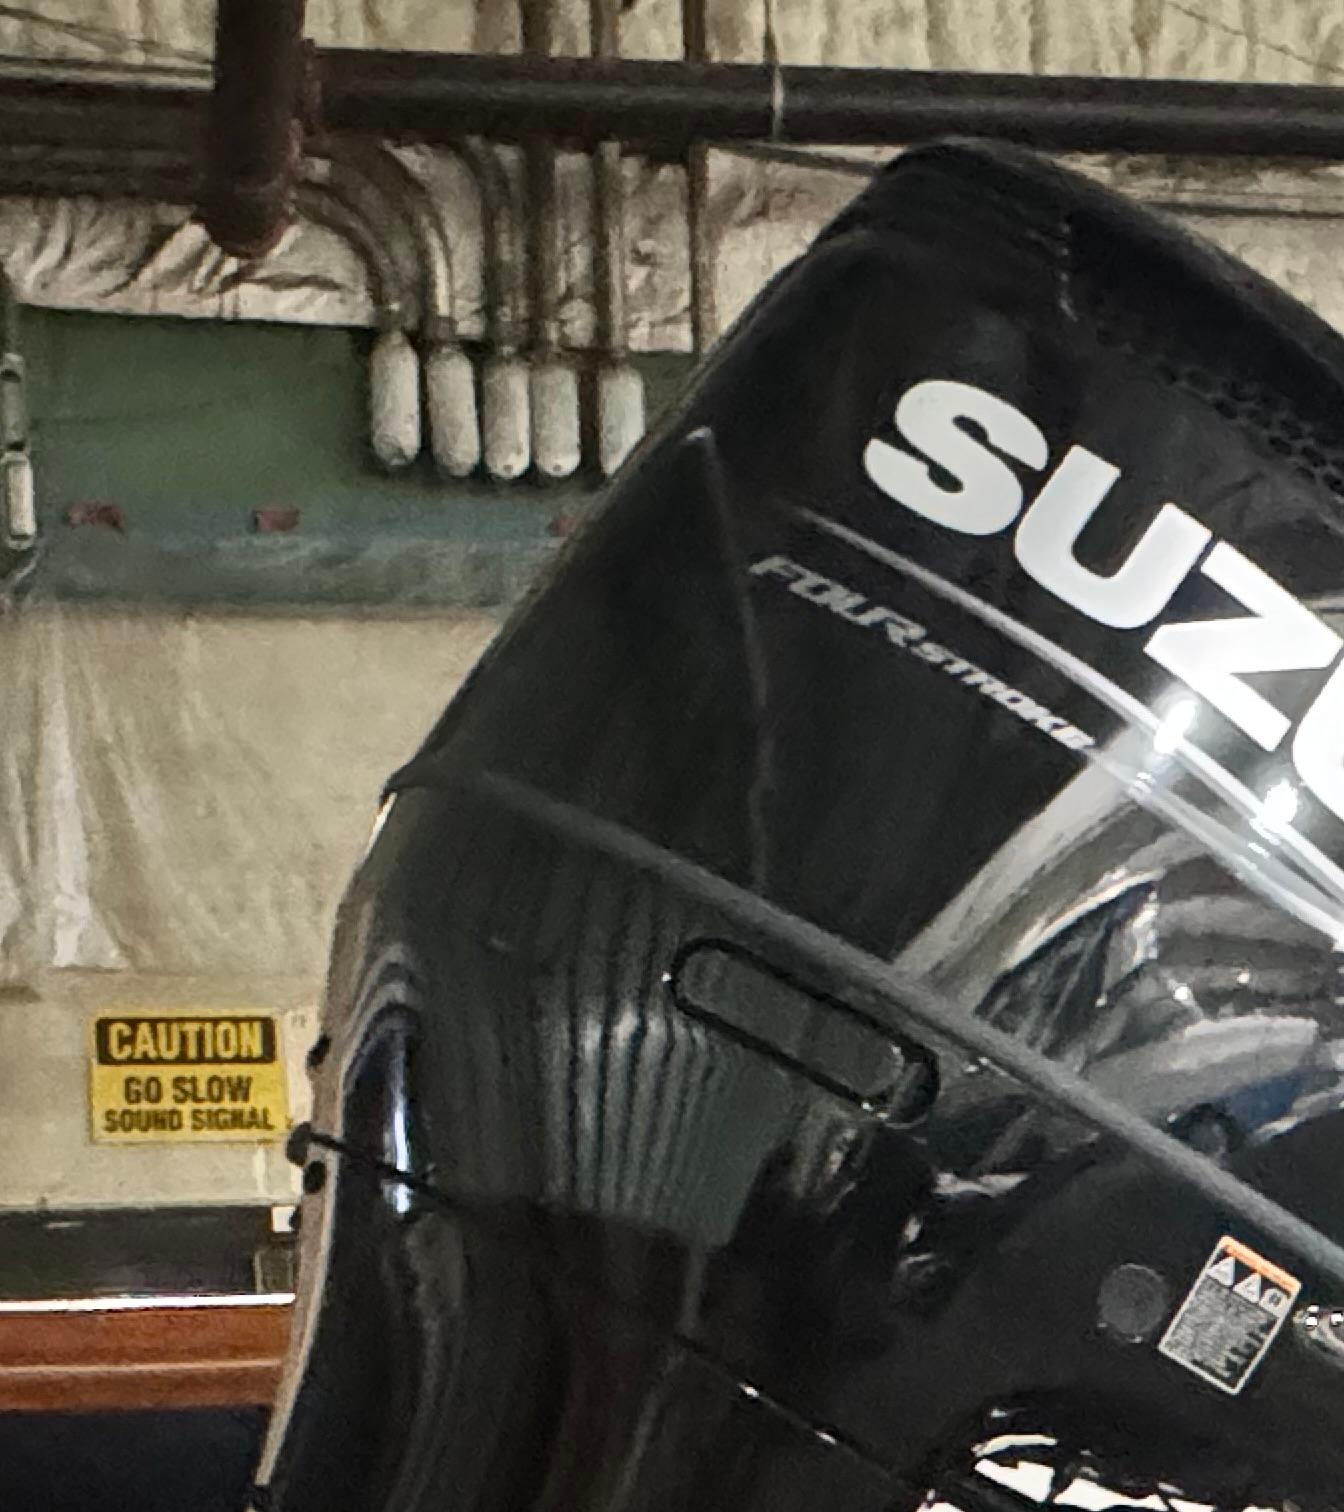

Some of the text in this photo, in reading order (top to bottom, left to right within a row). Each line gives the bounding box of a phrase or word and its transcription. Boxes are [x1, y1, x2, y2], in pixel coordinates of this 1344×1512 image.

[109, 1021, 263, 1060] CAUTION
[125, 1075, 253, 1104] GO SLOW
[103, 1108, 275, 1132] SOUND SIGNAL
